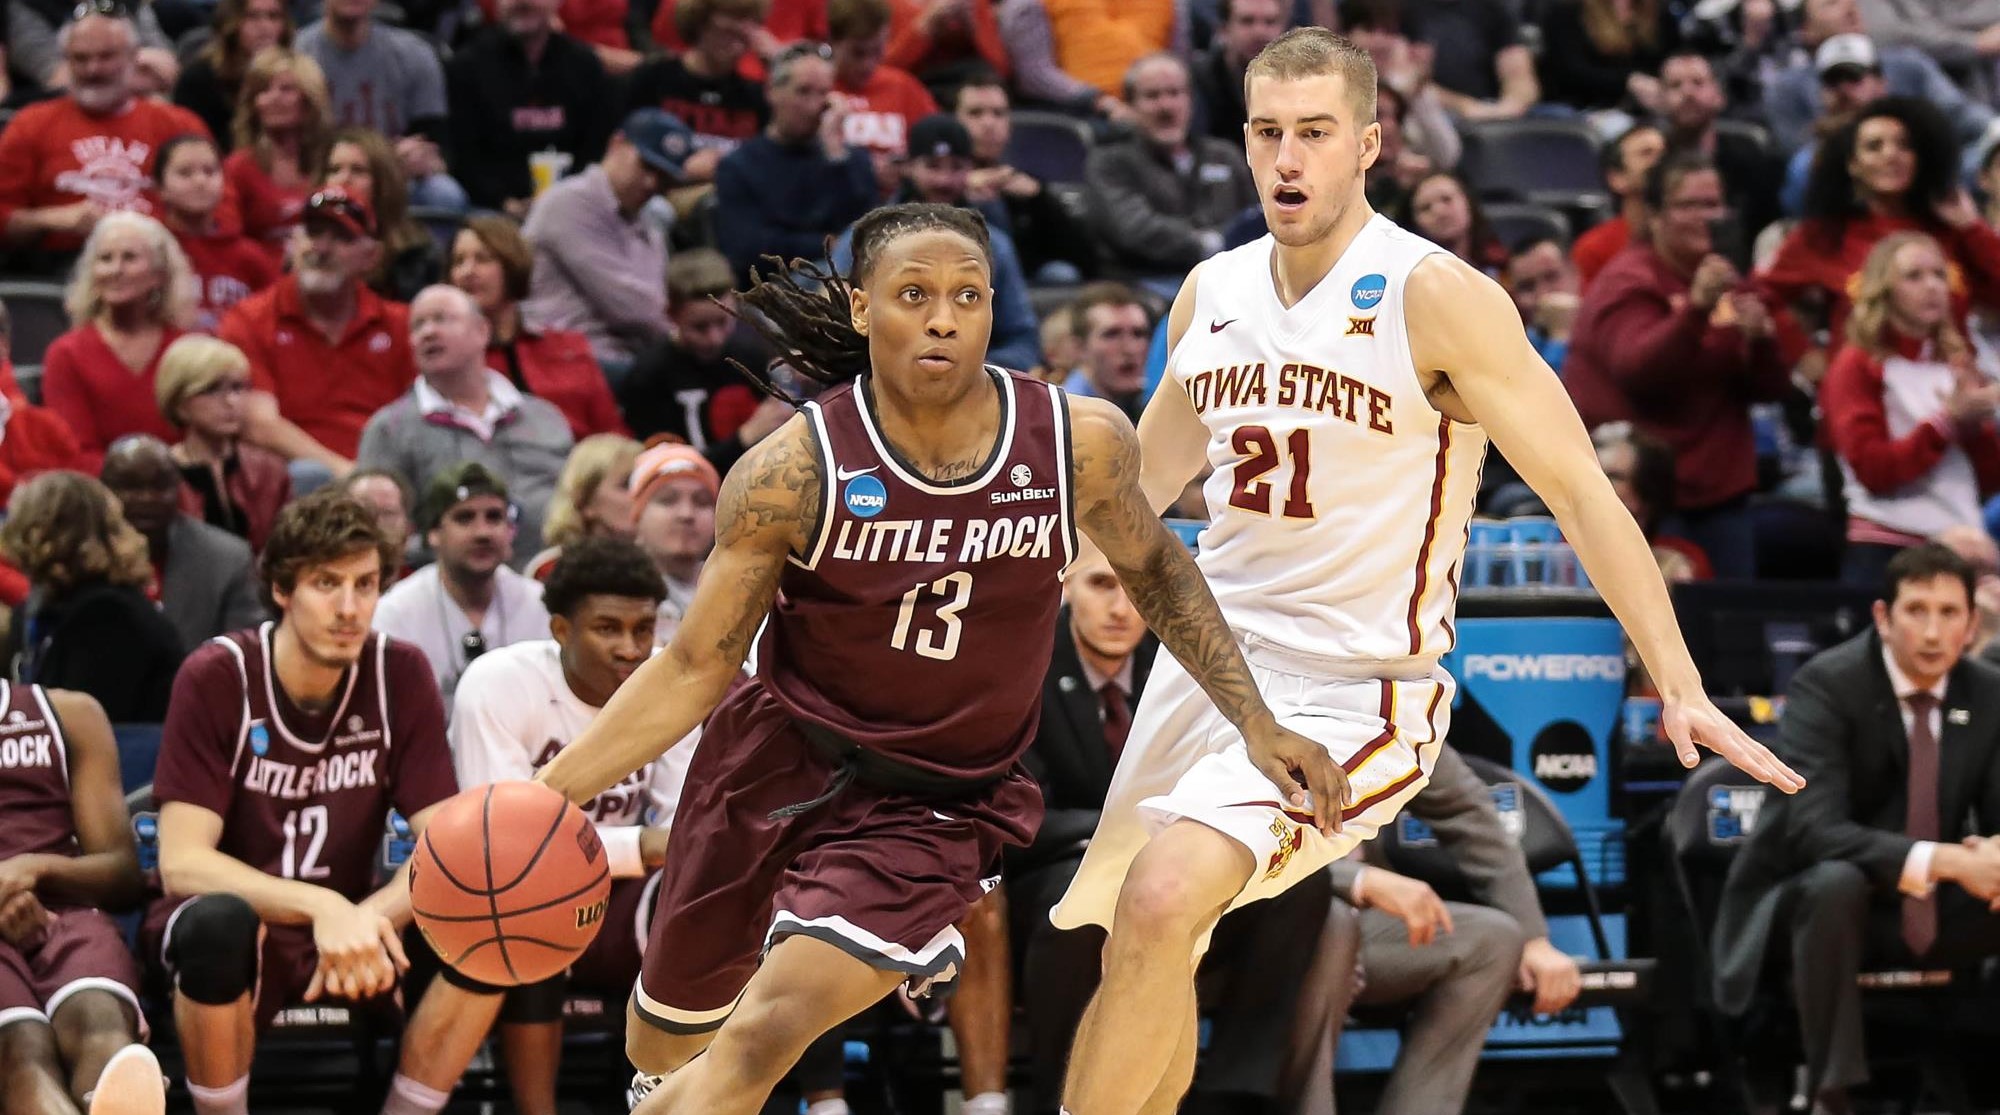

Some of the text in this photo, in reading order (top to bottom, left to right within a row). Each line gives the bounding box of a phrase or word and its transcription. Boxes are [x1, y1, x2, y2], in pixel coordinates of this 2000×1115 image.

[1345, 315, 1378, 336] XII
[1184, 362, 1394, 436] IOWA STATE
[1228, 424, 1316, 520] 21
[850, 493, 884, 508] NCAA
[832, 513, 1059, 563] LITTLE ROCK
[890, 570, 974, 661] 13
[0, 734, 52, 768] OCK
[244, 748, 379, 800] LITTLE ROCK
[1534, 753, 1597, 779] NCAA
[281, 804, 332, 880] 12
